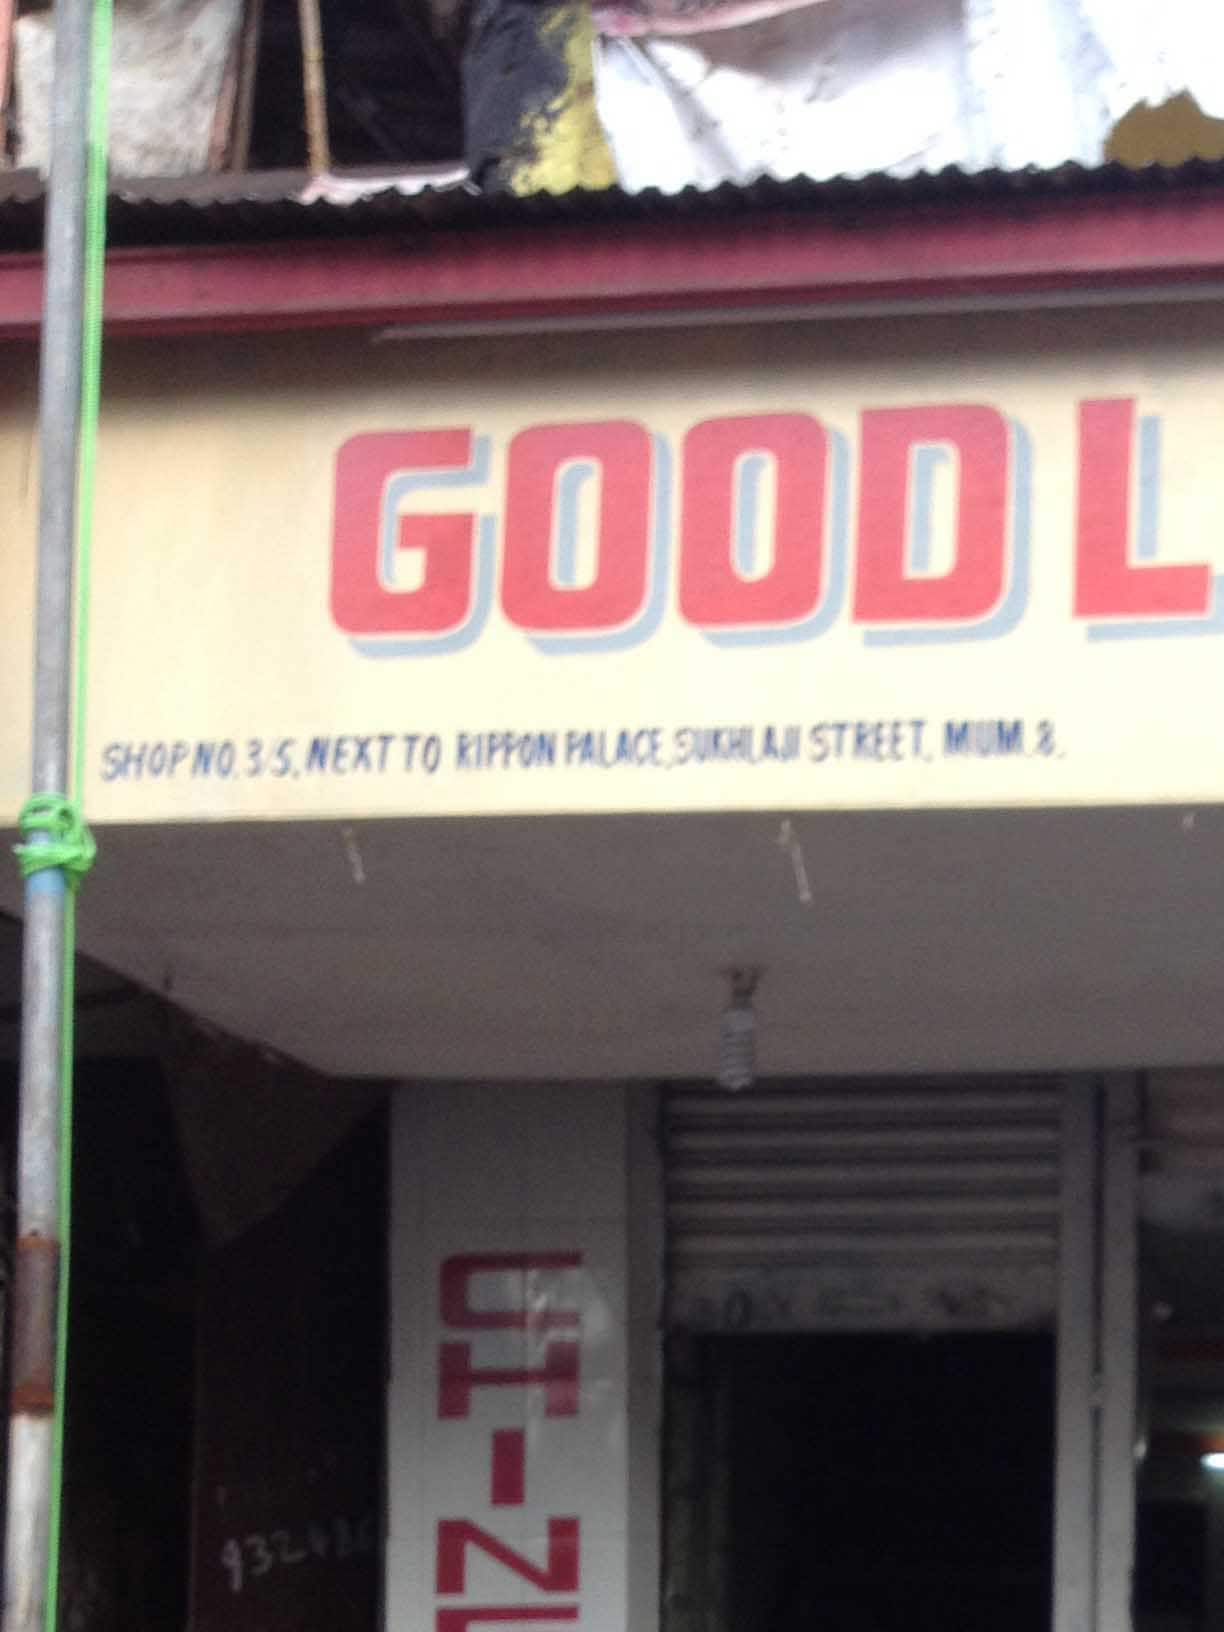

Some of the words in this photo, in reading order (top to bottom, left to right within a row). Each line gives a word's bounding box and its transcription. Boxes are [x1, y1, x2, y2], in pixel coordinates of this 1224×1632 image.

[330, 403, 1030, 655] GOOD
[101, 740, 190, 782] SHOP
[402, 731, 442, 775] TO
[455, 728, 556, 770] RIPPON
